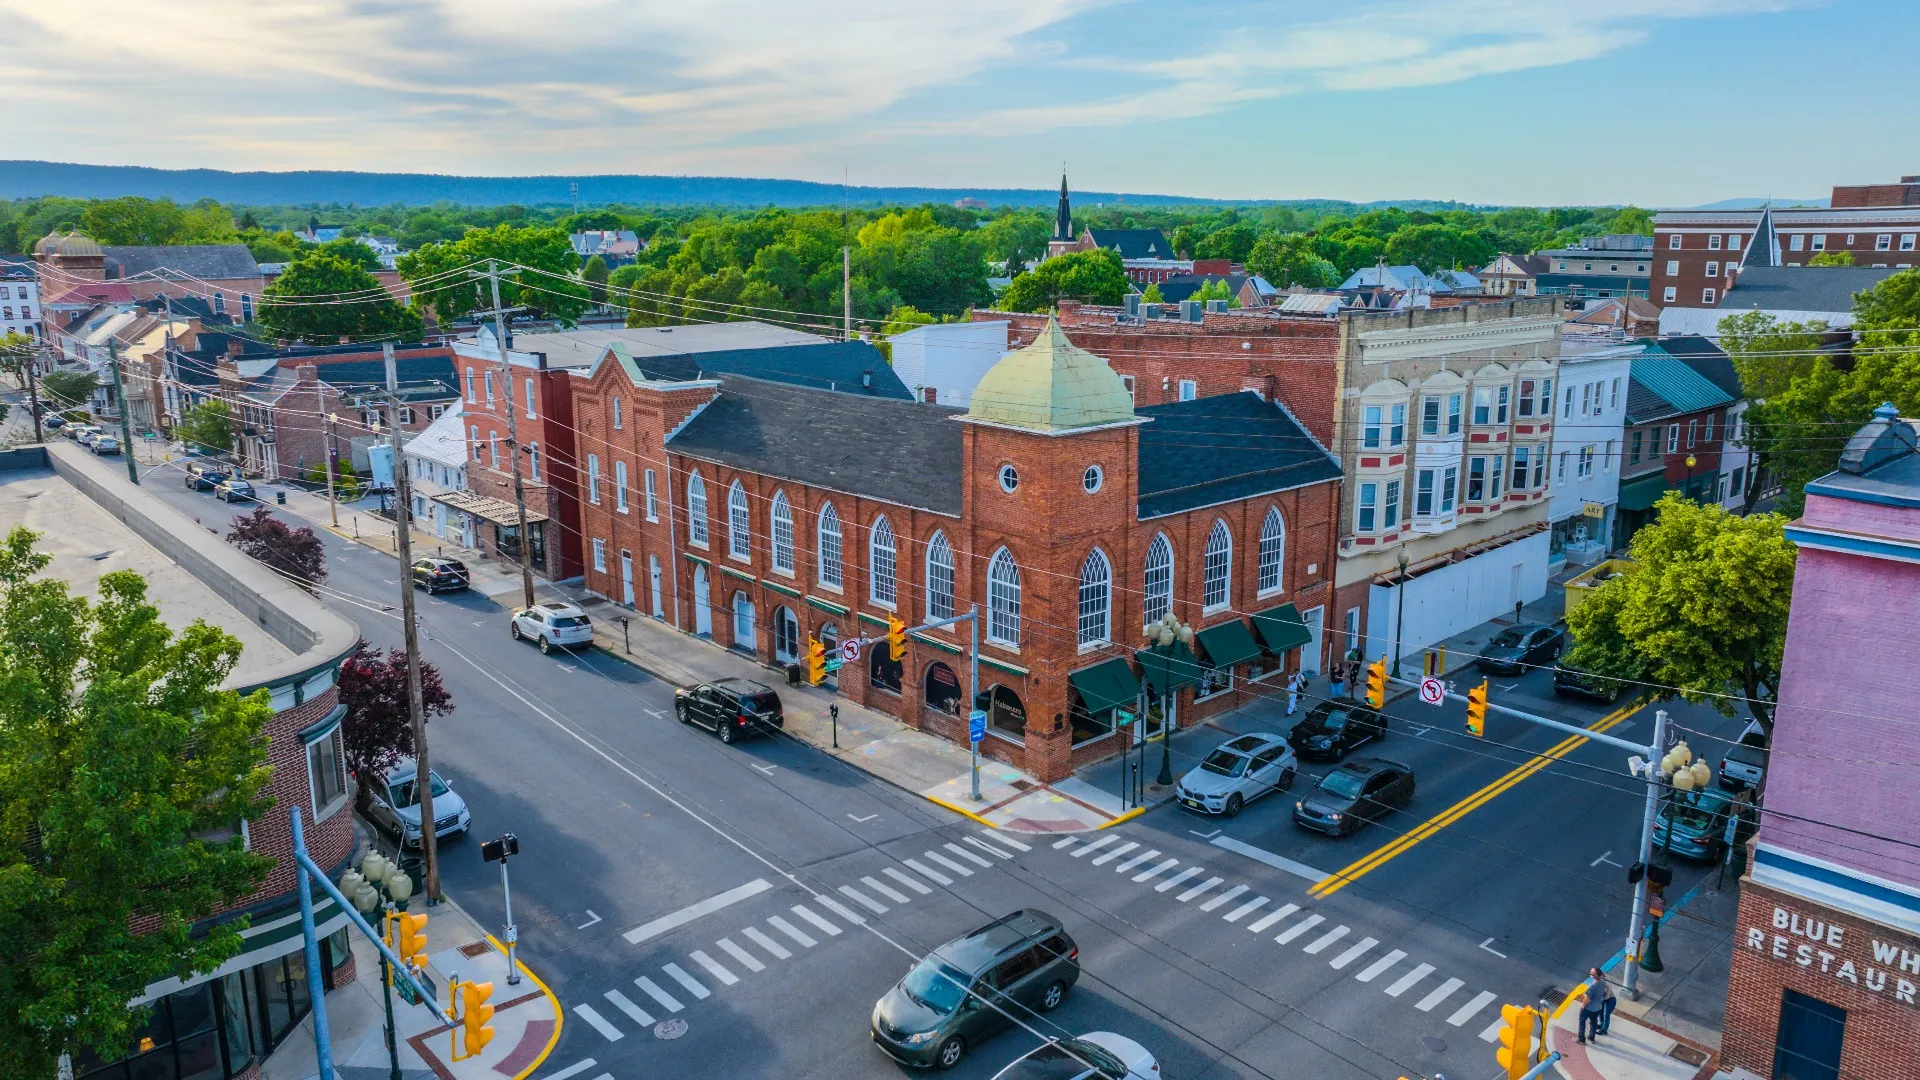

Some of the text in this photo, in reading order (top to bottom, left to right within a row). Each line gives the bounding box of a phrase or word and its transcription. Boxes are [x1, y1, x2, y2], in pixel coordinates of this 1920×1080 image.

[1585, 507, 1601, 515] ART
[1747, 927, 1917, 1005] RESTAUR
[1772, 907, 1920, 976] BLUE WH
